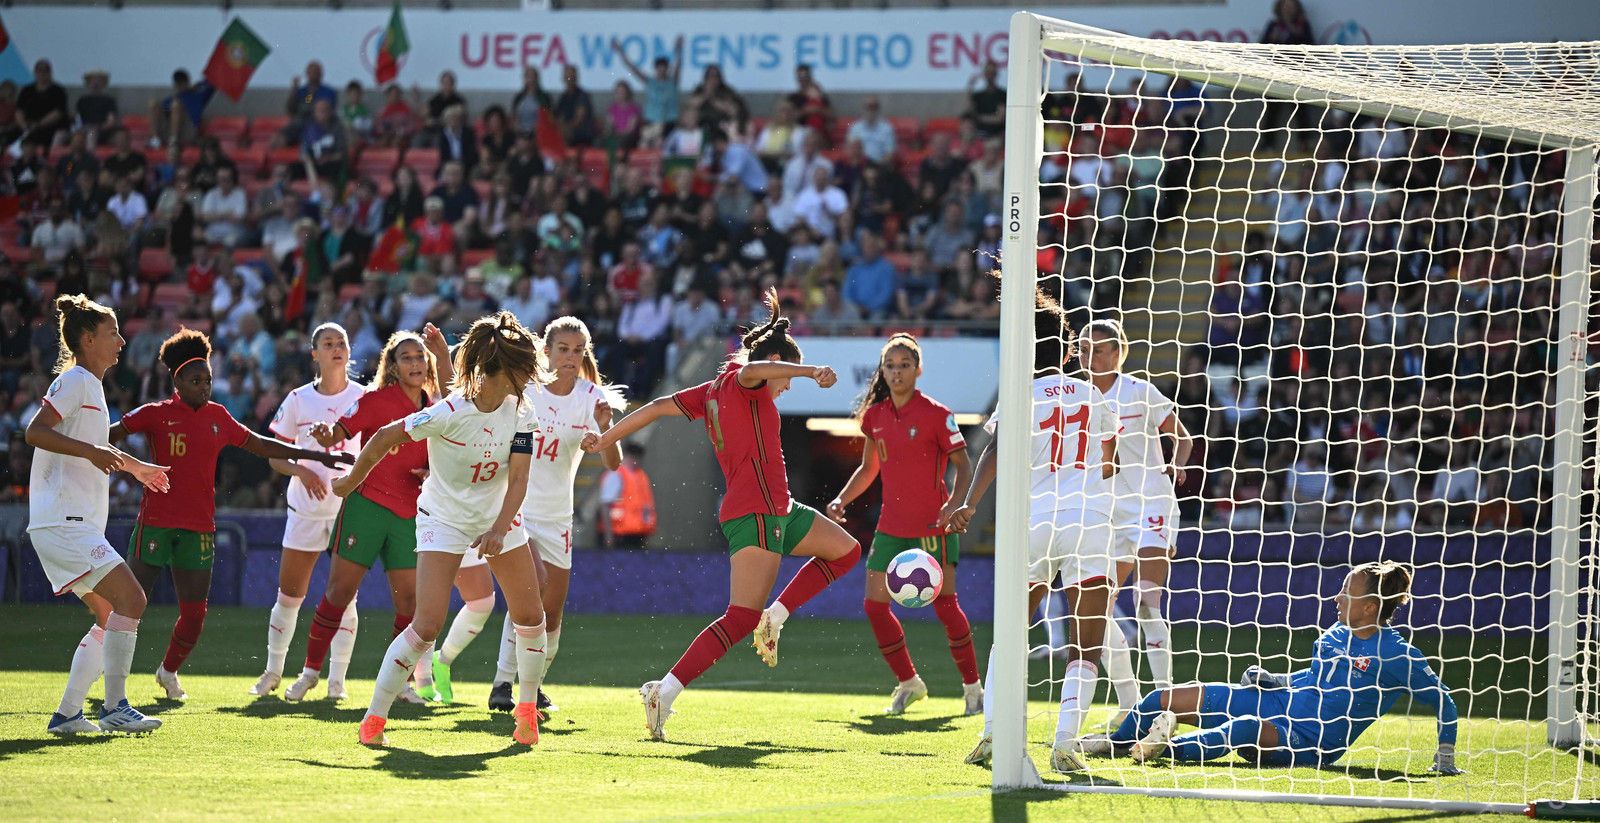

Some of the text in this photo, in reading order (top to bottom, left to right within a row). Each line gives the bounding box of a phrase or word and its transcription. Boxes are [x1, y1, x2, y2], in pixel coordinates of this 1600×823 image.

[459, 33, 568, 69] UEFA
[579, 33, 781, 69] WOMEN'S
[795, 33, 913, 69] EURO
[1010, 195, 1020, 232] PRO
[1044, 384, 1075, 397] SOW
[167, 432, 187, 457] 16
[535, 435, 560, 462] 14
[1039, 405, 1090, 472] 11
[469, 461, 499, 484] 13
